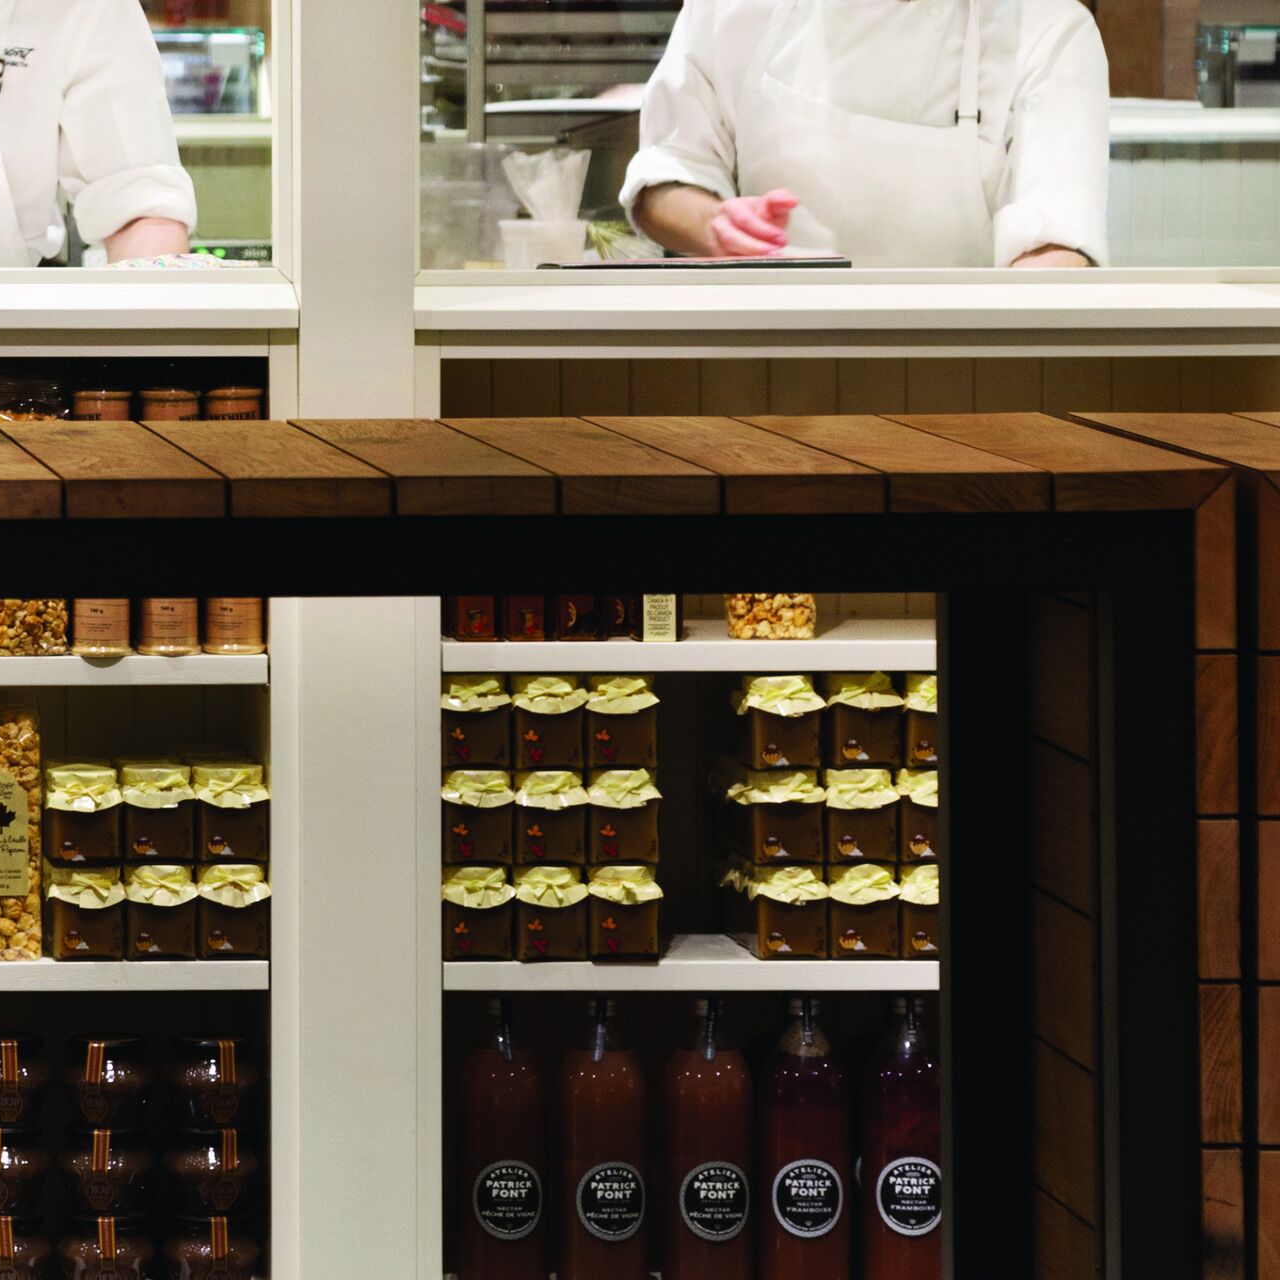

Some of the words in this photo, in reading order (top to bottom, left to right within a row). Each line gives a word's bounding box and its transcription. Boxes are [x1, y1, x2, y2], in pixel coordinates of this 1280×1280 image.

[490, 1167, 529, 1179] ATELIER
[594, 1169, 633, 1180] ATELIER
[698, 1168, 737, 1180] ATELIER
[790, 1166, 829, 1178] ATELIER
[893, 1165, 932, 1176] ATELIER
[486, 1180, 533, 1189] PATRICK
[590, 1181, 637, 1190] PATRICK
[693, 1181, 741, 1190] PATRICK
[785, 1178, 832, 1188] PATRICK
[888, 1176, 936, 1185] PATRICK
[491, 1189, 528, 1198] FONT
[596, 1190, 633, 1200] FONT
[699, 1190, 736, 1200] FONT
[791, 1187, 828, 1197] FONT
[895, 1185, 932, 1195] FONT
